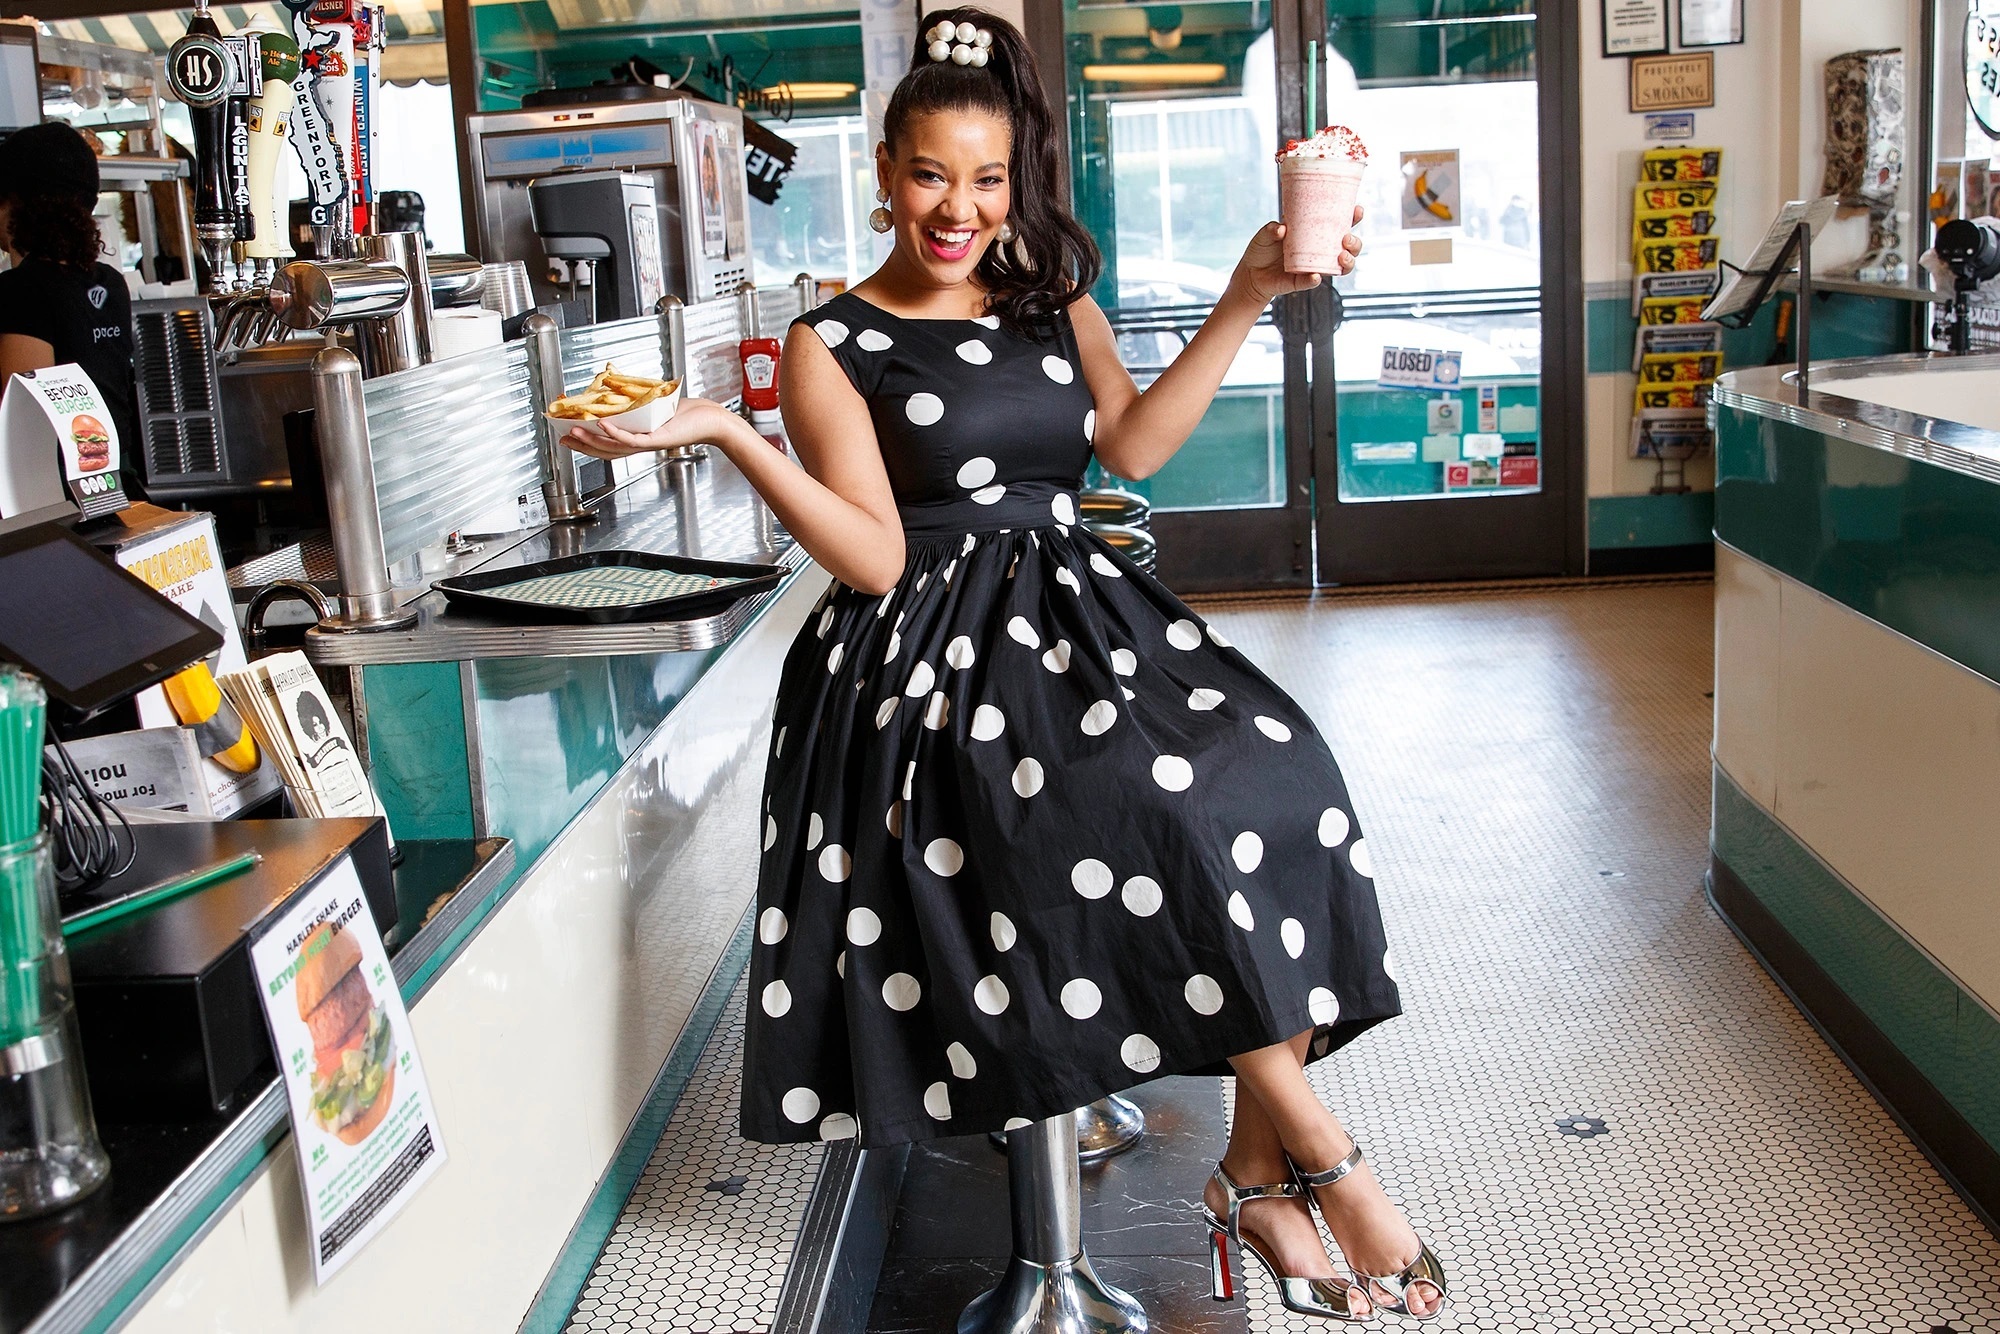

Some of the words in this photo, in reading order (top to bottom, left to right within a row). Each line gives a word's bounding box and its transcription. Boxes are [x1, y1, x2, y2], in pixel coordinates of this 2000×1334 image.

[186, 54, 213, 87] HS
[253, 41, 262, 94] IPA
[267, 58, 280, 66] Ale
[1643, 64, 1702, 76] POSITIVELY
[1663, 75, 1684, 85] NO
[1642, 86, 1704, 100] SMOKING
[293, 81, 332, 193] GREENPORT
[231, 116, 250, 206] LAGUNITAS
[311, 205, 327, 224] G
[1383, 351, 1432, 372] CLOSED
[44, 384, 88, 401] BEYOND
[53, 397, 97, 415] BURGER
[132, 783, 157, 797] For
[285, 921, 317, 956] HARLEM
[316, 898, 340, 927] SHAKE
[269, 953, 306, 997] BEYOND
[307, 928, 331, 958] MEAT
[331, 898, 363, 936] BURGER
[312, 1144, 326, 1163] NO
